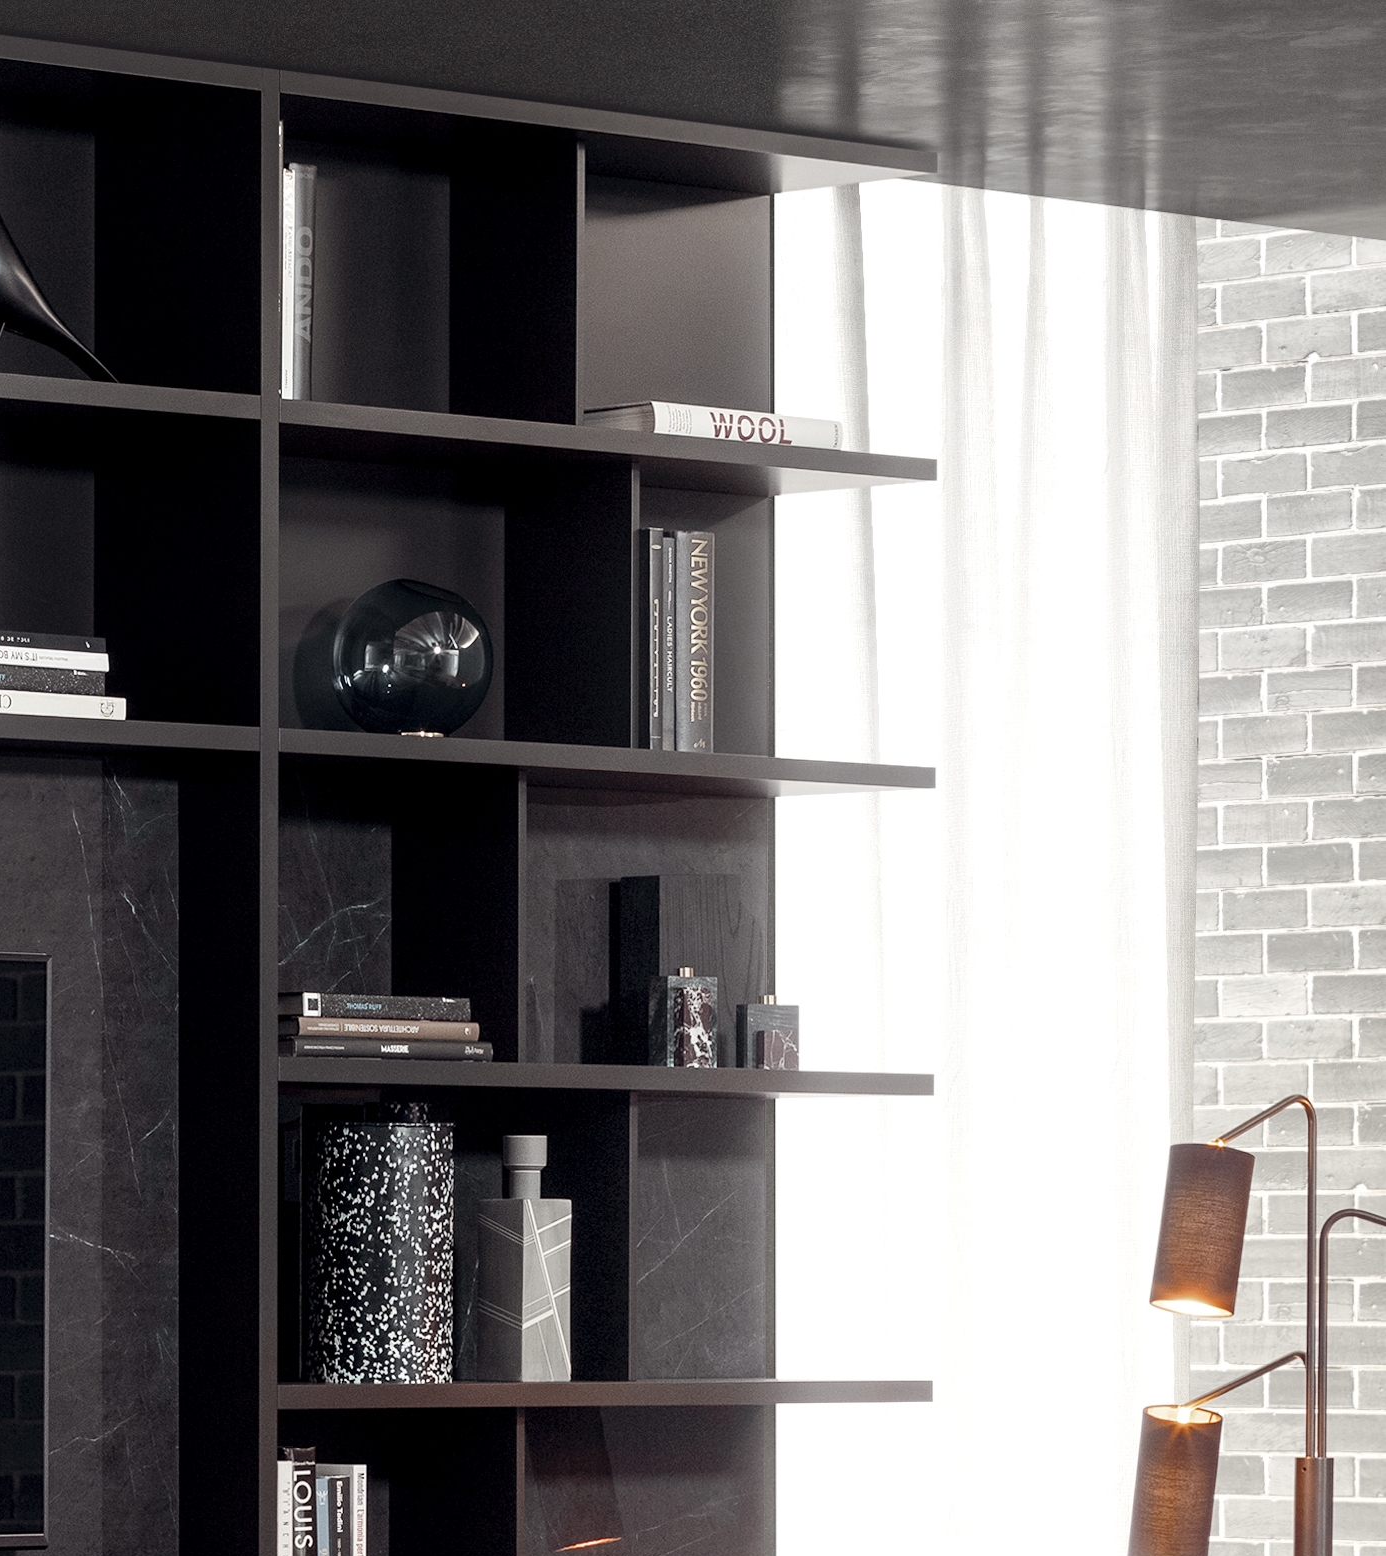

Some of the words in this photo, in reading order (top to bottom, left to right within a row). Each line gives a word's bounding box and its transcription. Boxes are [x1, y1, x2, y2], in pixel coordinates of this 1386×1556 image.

[295, 226, 313, 344] ANDO
[709, 411, 792, 446] WOOL
[690, 538, 708, 593] NEW
[6, 635, 15, 643] DE
[690, 594, 708, 654] YORK
[9, 650, 24, 661] MY
[24, 651, 38, 663] IT'S
[690, 657, 708, 702] 1960
[380, 1044, 409, 1054] MASSERIE
[336, 1480, 344, 1507] Emilio
[357, 1472, 365, 1505] Mondrian
[292, 1469, 314, 1549] LOUIS
[336, 1507, 344, 1533] Tadini
[357, 1508, 365, 1542] L'armonia
